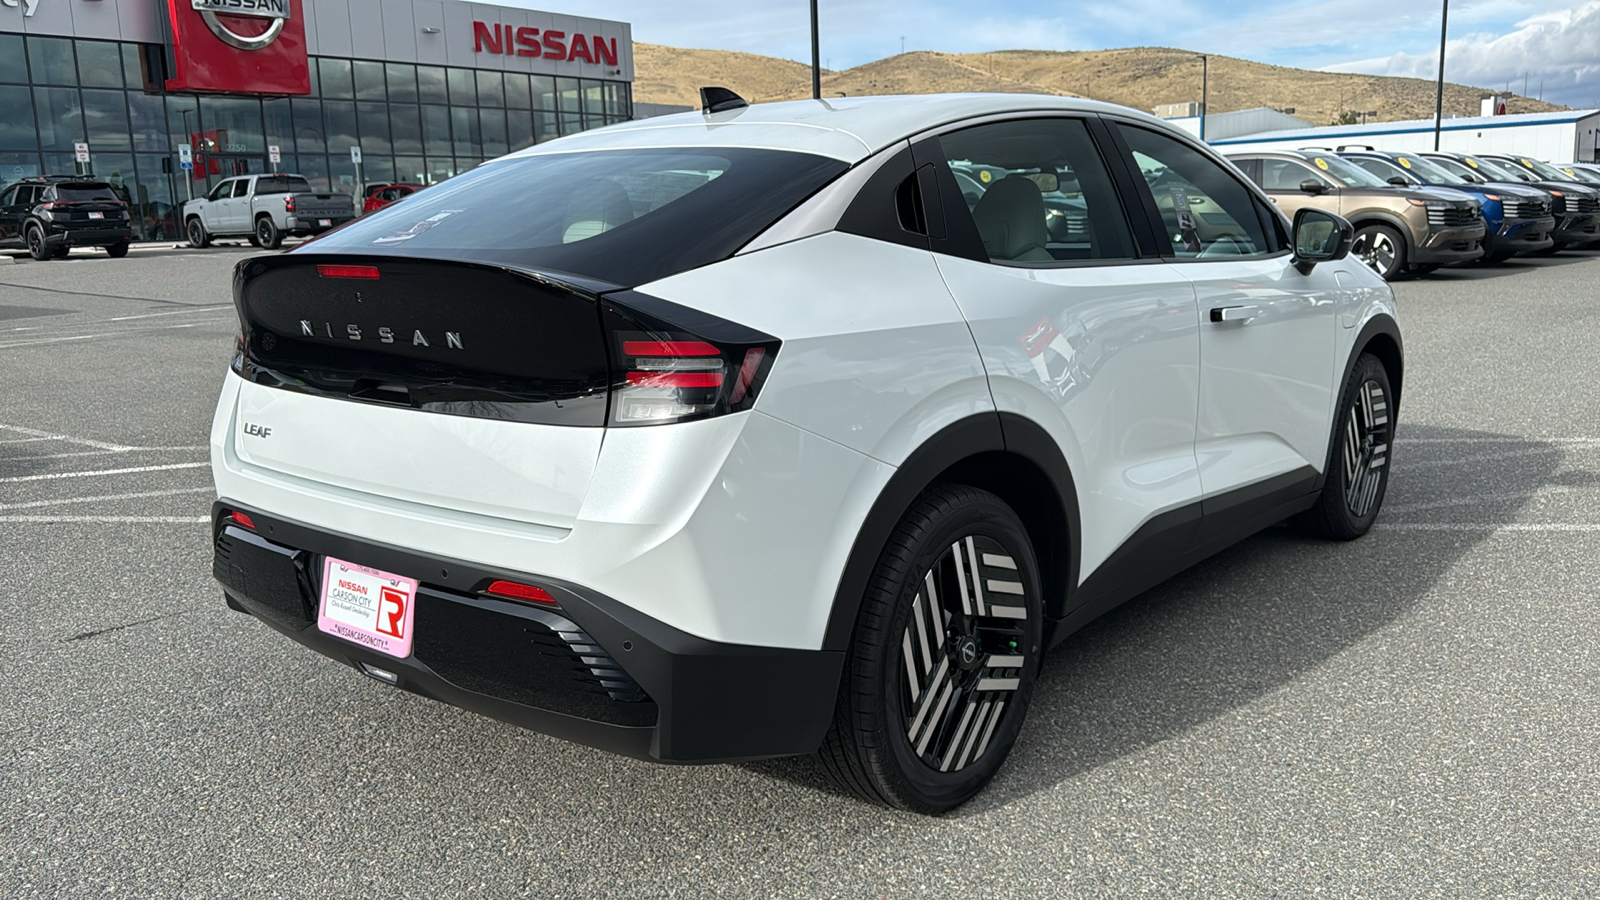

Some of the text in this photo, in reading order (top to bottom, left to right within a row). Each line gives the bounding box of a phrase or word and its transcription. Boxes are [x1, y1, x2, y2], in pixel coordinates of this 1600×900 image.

[473, 21, 618, 66] NISSAN
[300, 319, 464, 349] NISSAN
[244, 422, 272, 438] LEAF
[332, 587, 372, 608] CARSON CITY
[338, 579, 368, 595] NISSAN
